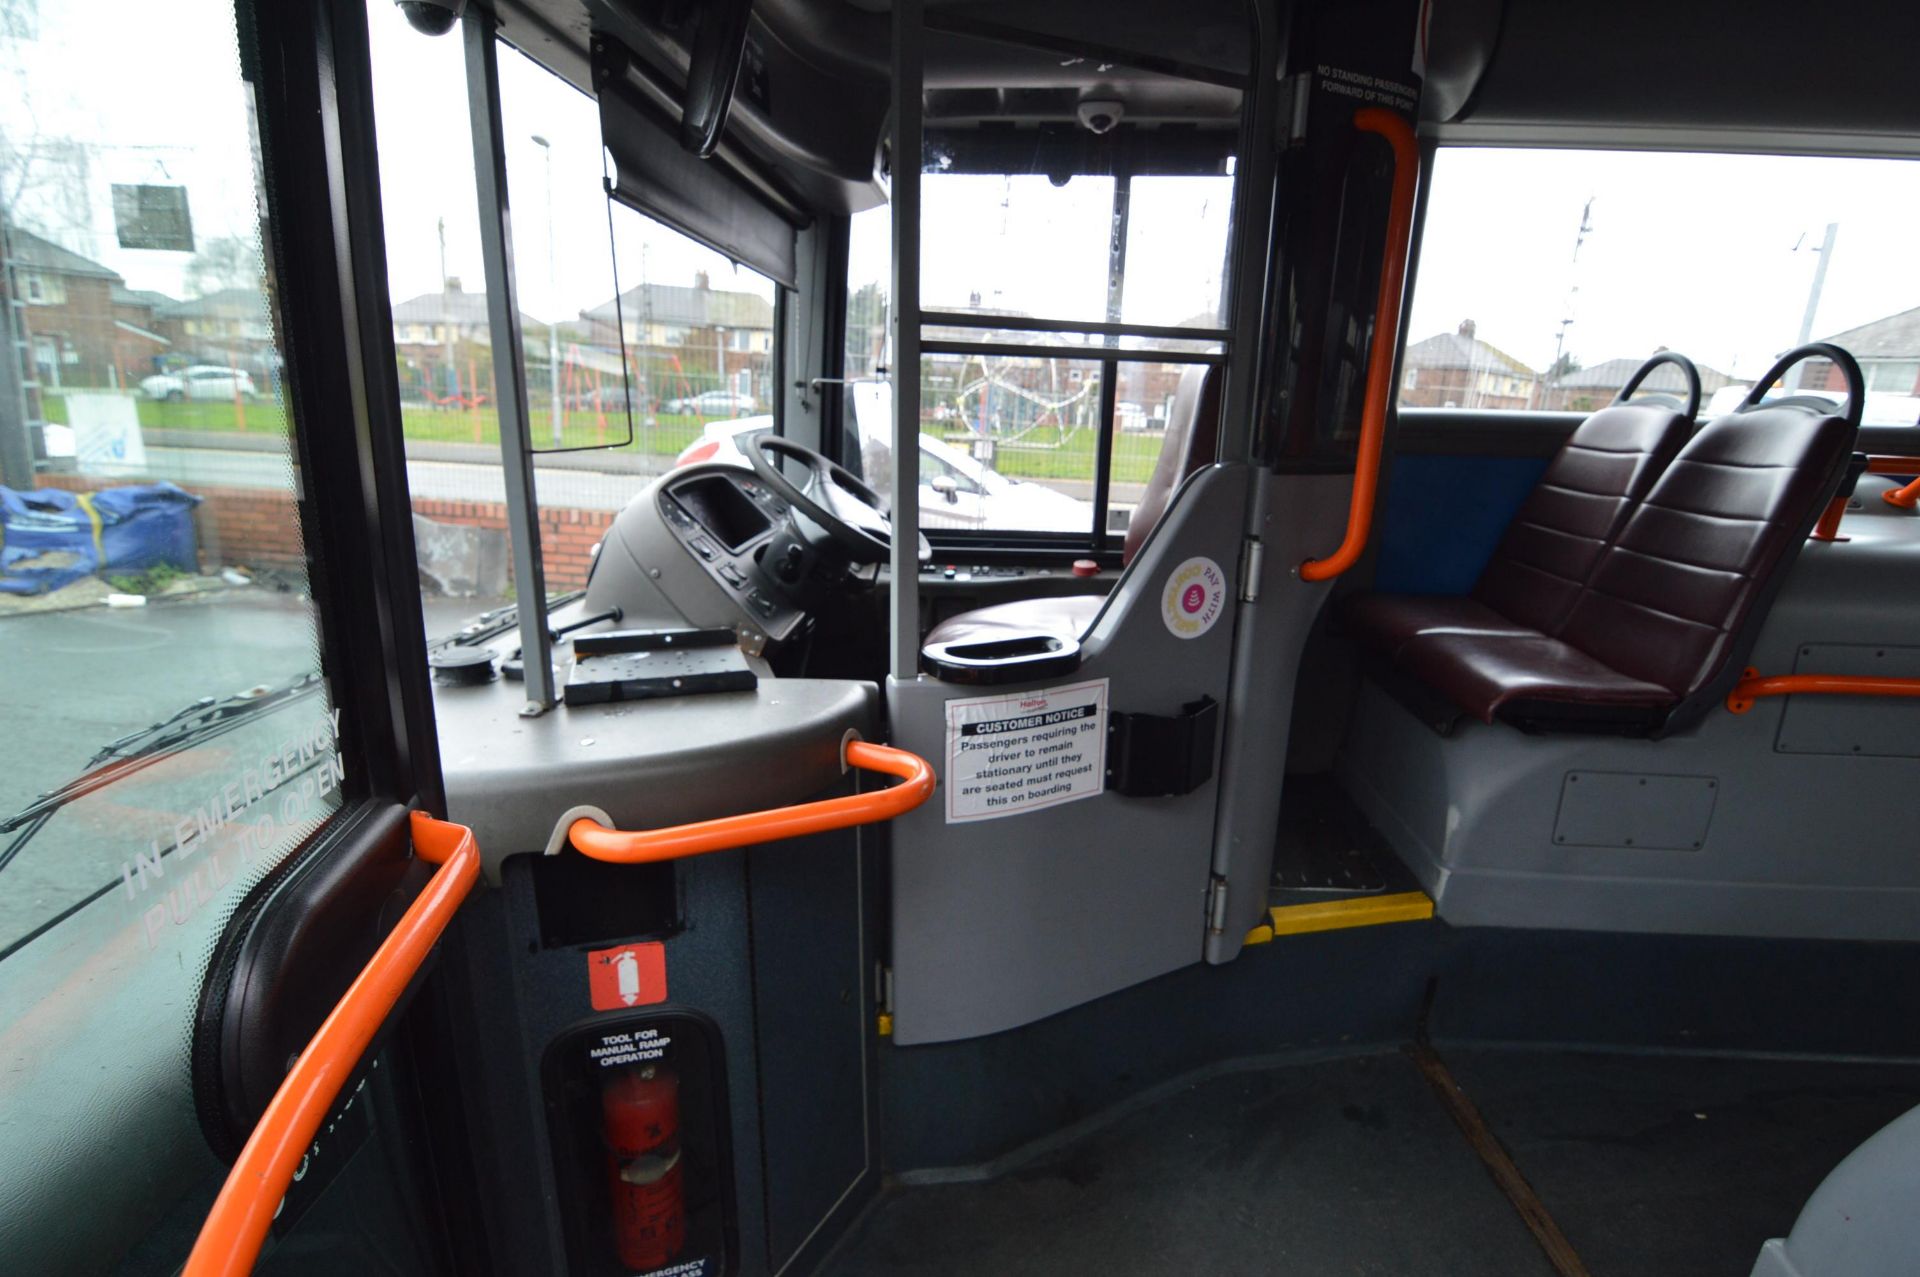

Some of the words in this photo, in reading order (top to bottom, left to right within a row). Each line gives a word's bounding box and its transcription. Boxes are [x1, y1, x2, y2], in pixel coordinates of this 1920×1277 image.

[1317, 63, 1330, 77] NO
[1331, 67, 1373, 88] STANDING
[1321, 80, 1363, 99] FORWARD
[1364, 90, 1376, 101] OF
[1376, 92, 1394, 106] THIS
[1203, 567, 1220, 586] PAY
[1202, 590, 1221, 624] WITH
[976, 714, 1043, 734] CUSTOMER
[1045, 707, 1085, 724] NOTICE
[961, 735, 1028, 751] Passengers
[1031, 725, 1077, 743] requiring
[1080, 722, 1096, 733] the
[975, 763, 1033, 779] stationary
[1035, 756, 1059, 770] until
[1061, 752, 1083, 764] they
[988, 751, 1021, 764] driver
[1025, 749, 1035, 758] to
[1038, 741, 1073, 755] remain
[962, 786, 982, 795] are
[985, 779, 1023, 792] seated
[1026, 773, 1052, 786] must
[1055, 763, 1092, 780] request
[122, 840, 165, 901] IN
[173, 708, 341, 860] EMERGENCY
[987, 797, 1008, 807] this
[1011, 794, 1025, 803] on
[1028, 782, 1072, 800] boarding
[143, 853, 233, 950] PULL
[233, 813, 274, 863] TO
[283, 752, 345, 825] OPEN
[590, 1043, 637, 1058] MANUAL
[639, 1037, 671, 1050] RAMP
[601, 1033, 633, 1046] TOOL
[634, 1029, 658, 1041] FOR
[600, 1049, 663, 1067] OPERATION
